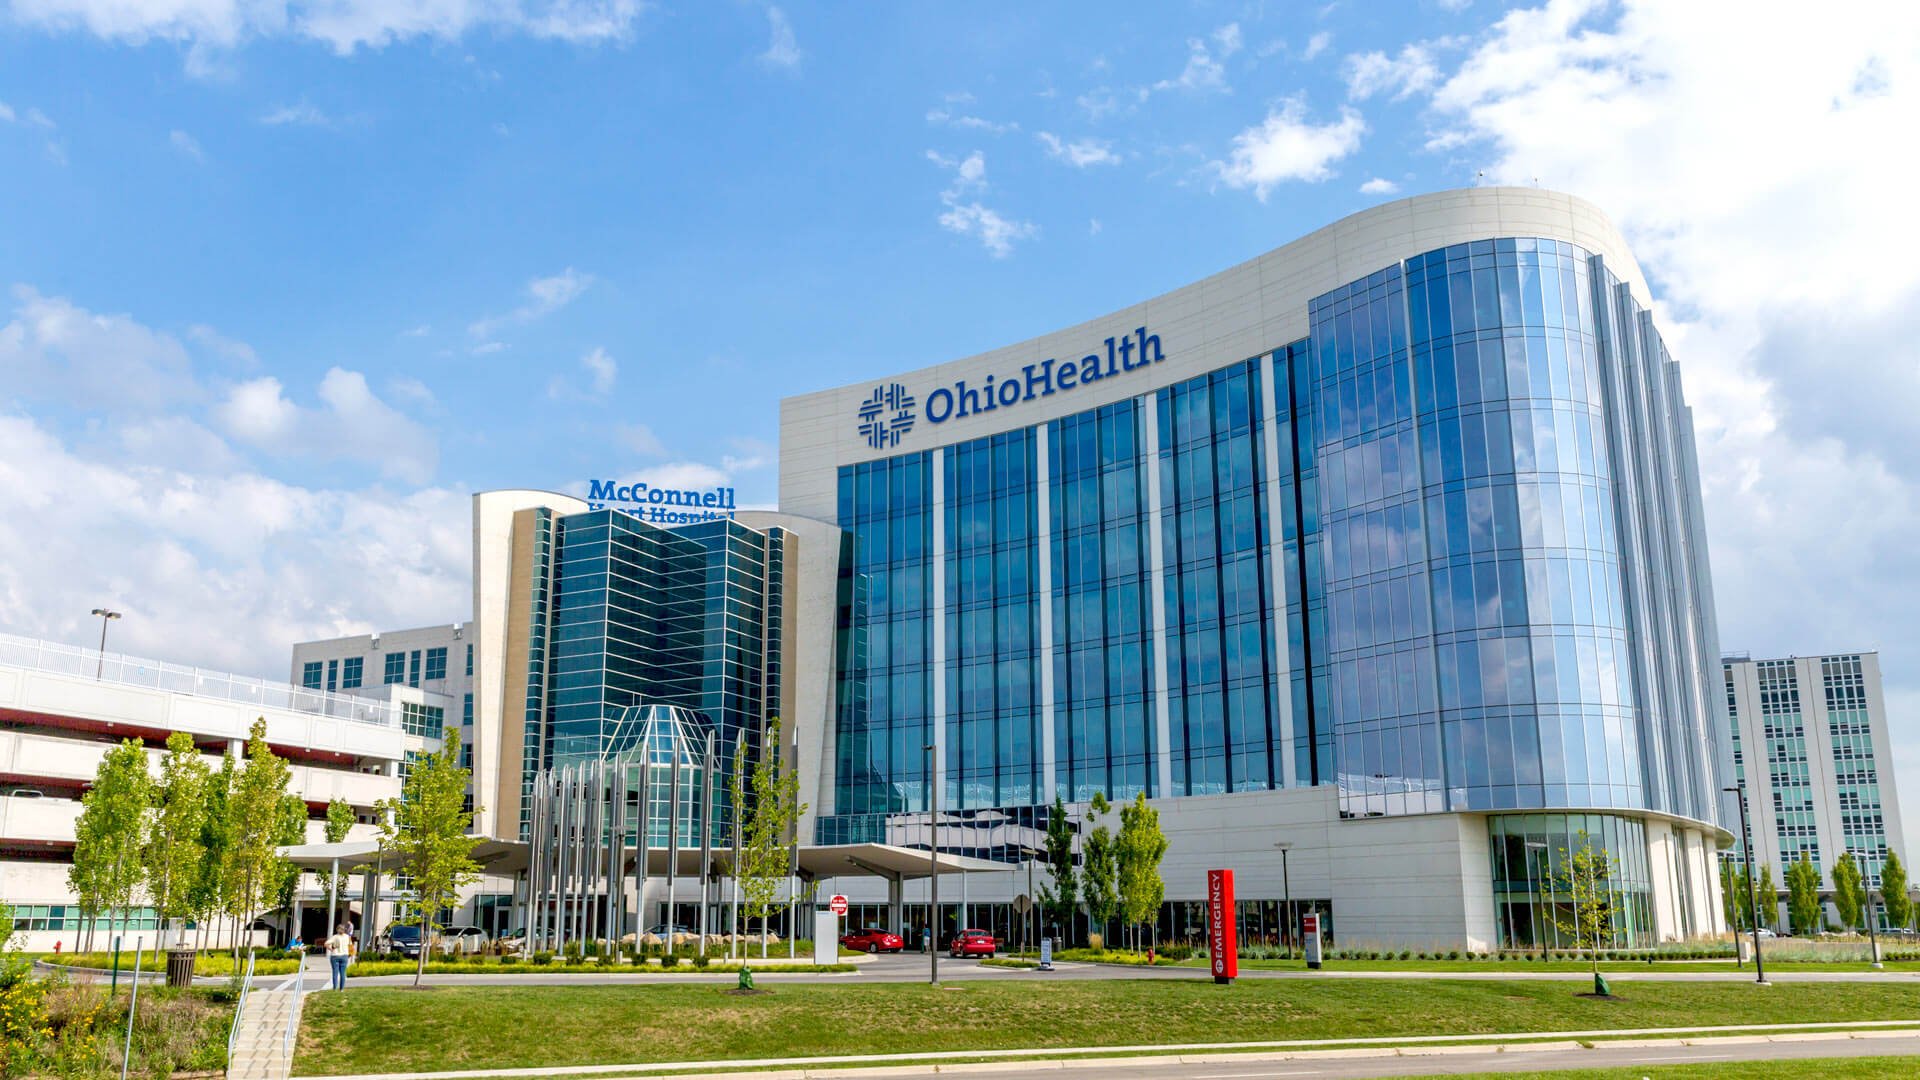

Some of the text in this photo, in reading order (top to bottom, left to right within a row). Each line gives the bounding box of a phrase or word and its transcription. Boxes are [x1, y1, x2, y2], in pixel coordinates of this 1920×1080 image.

[925, 326, 1165, 423] OhioHealth
[588, 480, 736, 509] McConnell
[588, 502, 645, 520] Hrt
[1212, 873, 1223, 959] EMERGENCY
